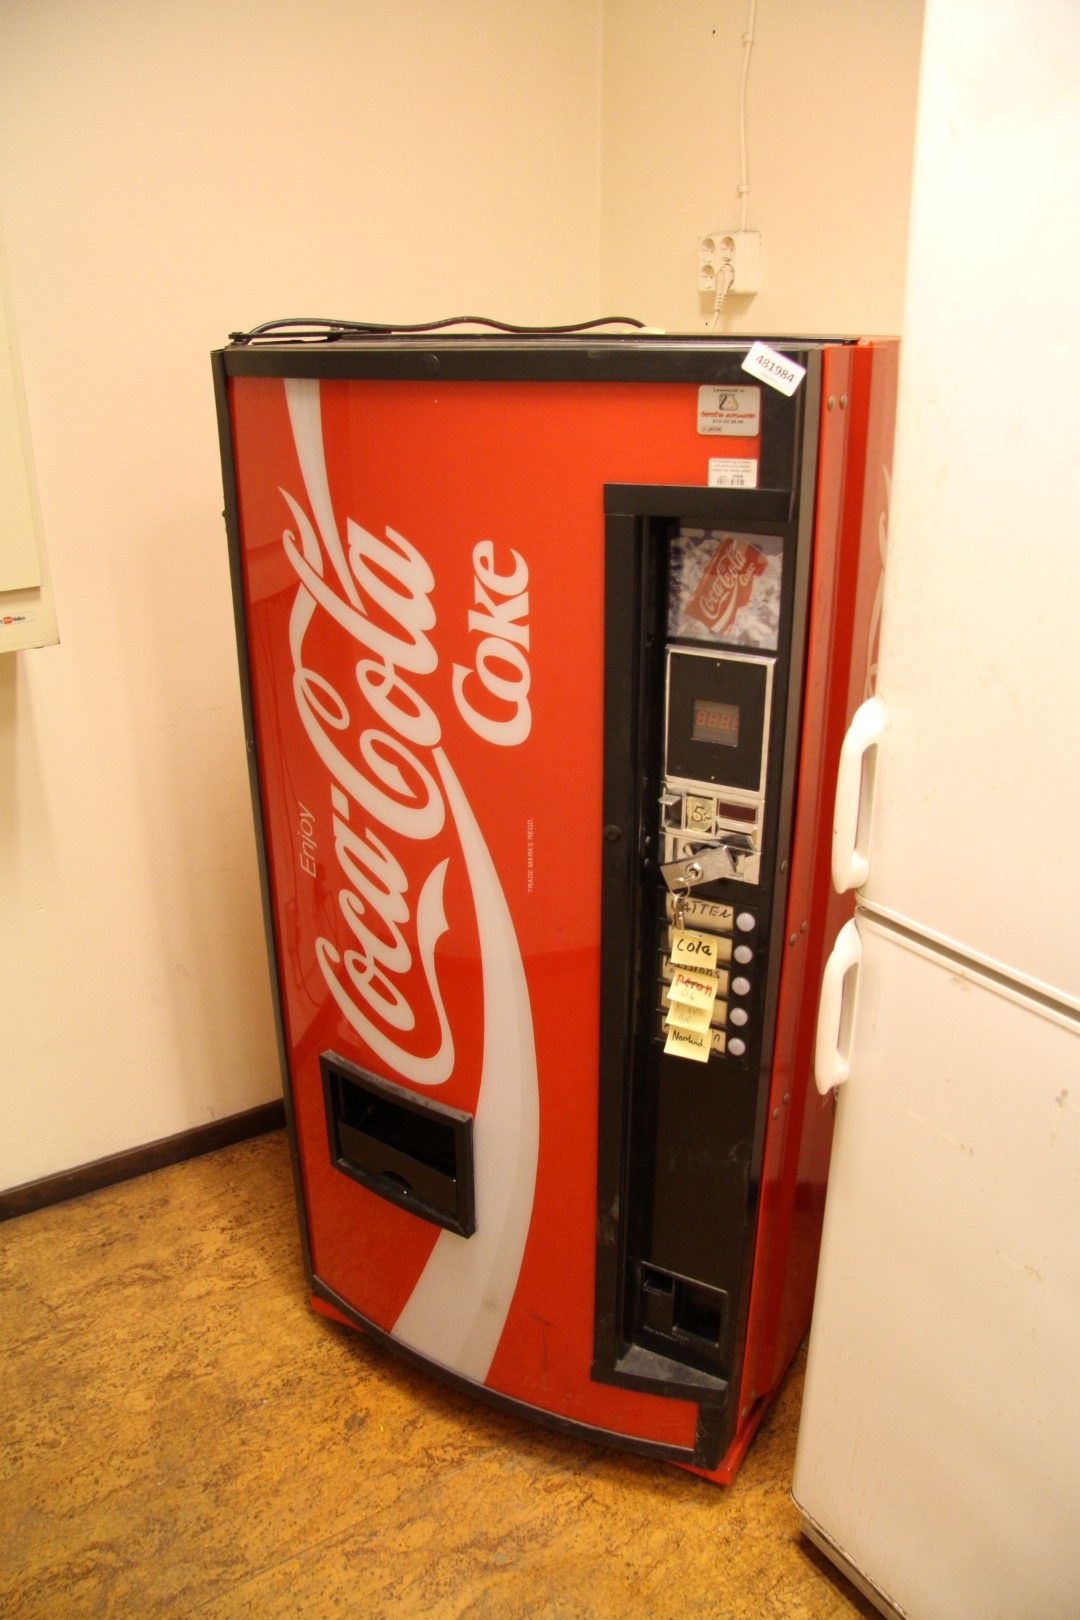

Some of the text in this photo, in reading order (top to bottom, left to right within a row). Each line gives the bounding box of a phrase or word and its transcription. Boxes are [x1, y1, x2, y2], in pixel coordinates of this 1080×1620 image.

[755, 355, 795, 383] 481984
[699, 542, 747, 620] Coca-Cola
[739, 563, 756, 586] Coke
[453, 539, 532, 747] Coke
[277, 486, 454, 1086] Coca-Cola
[297, 801, 317, 878] Enjoy
